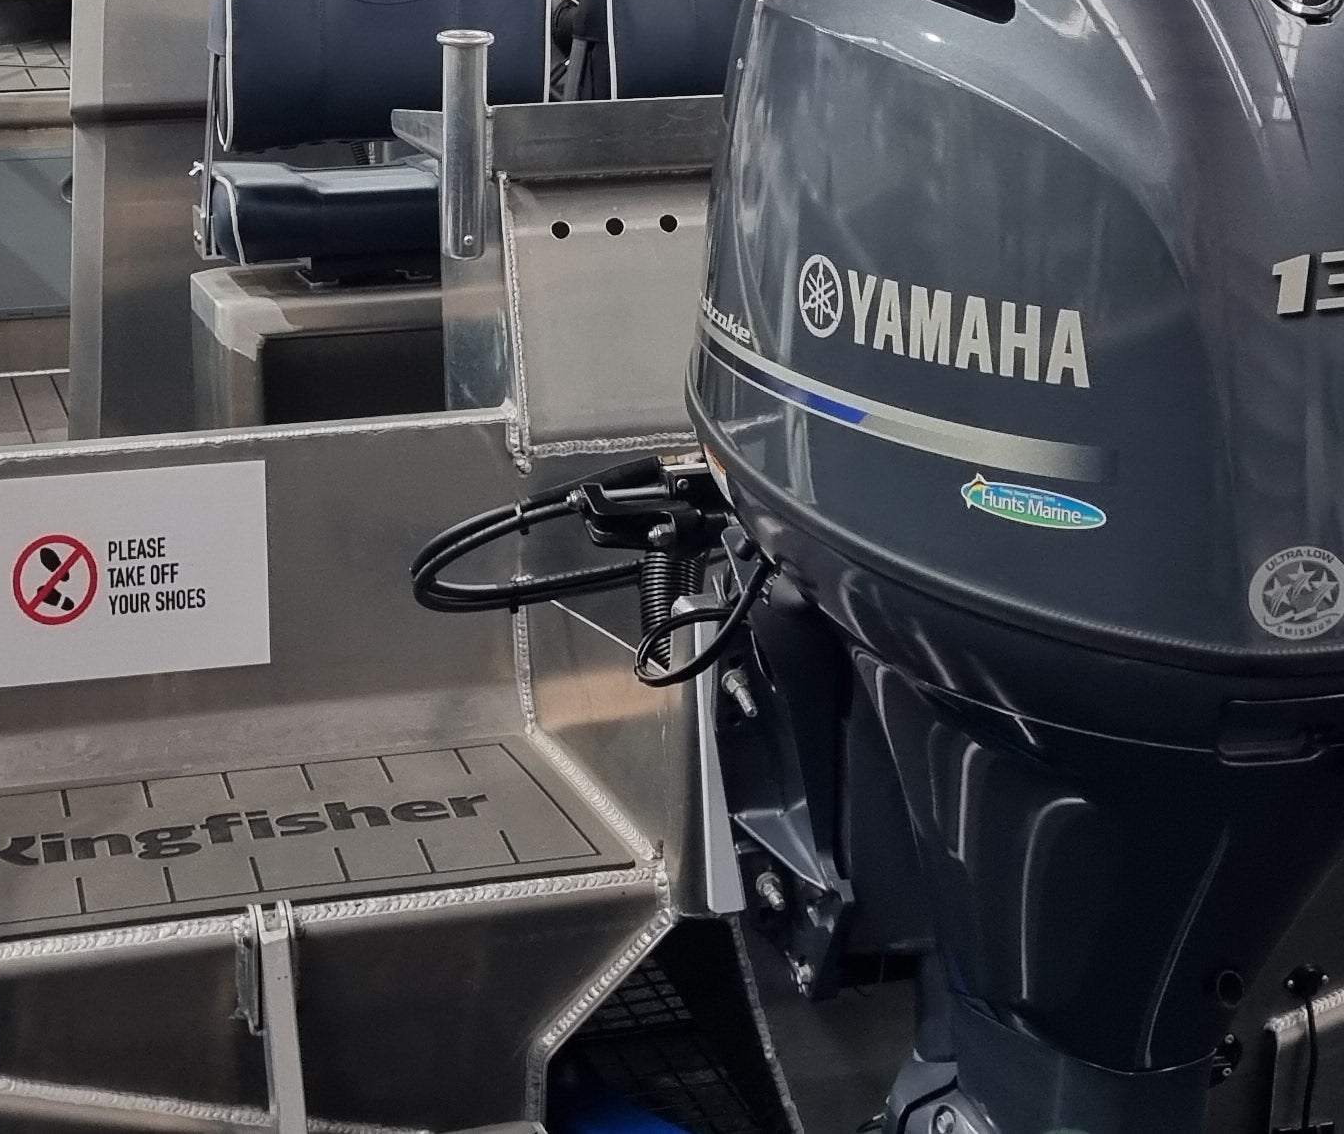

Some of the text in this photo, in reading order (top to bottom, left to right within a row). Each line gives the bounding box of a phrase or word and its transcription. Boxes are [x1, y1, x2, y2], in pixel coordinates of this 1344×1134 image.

[848, 270, 1090, 388] YAMAHA
[981, 489, 1025, 514] Hunts
[1027, 499, 1082, 524] Marine
[108, 537, 165, 561] PLEASE
[107, 563, 179, 588] TAKE OFF
[109, 588, 206, 615] YOUR SHOES
